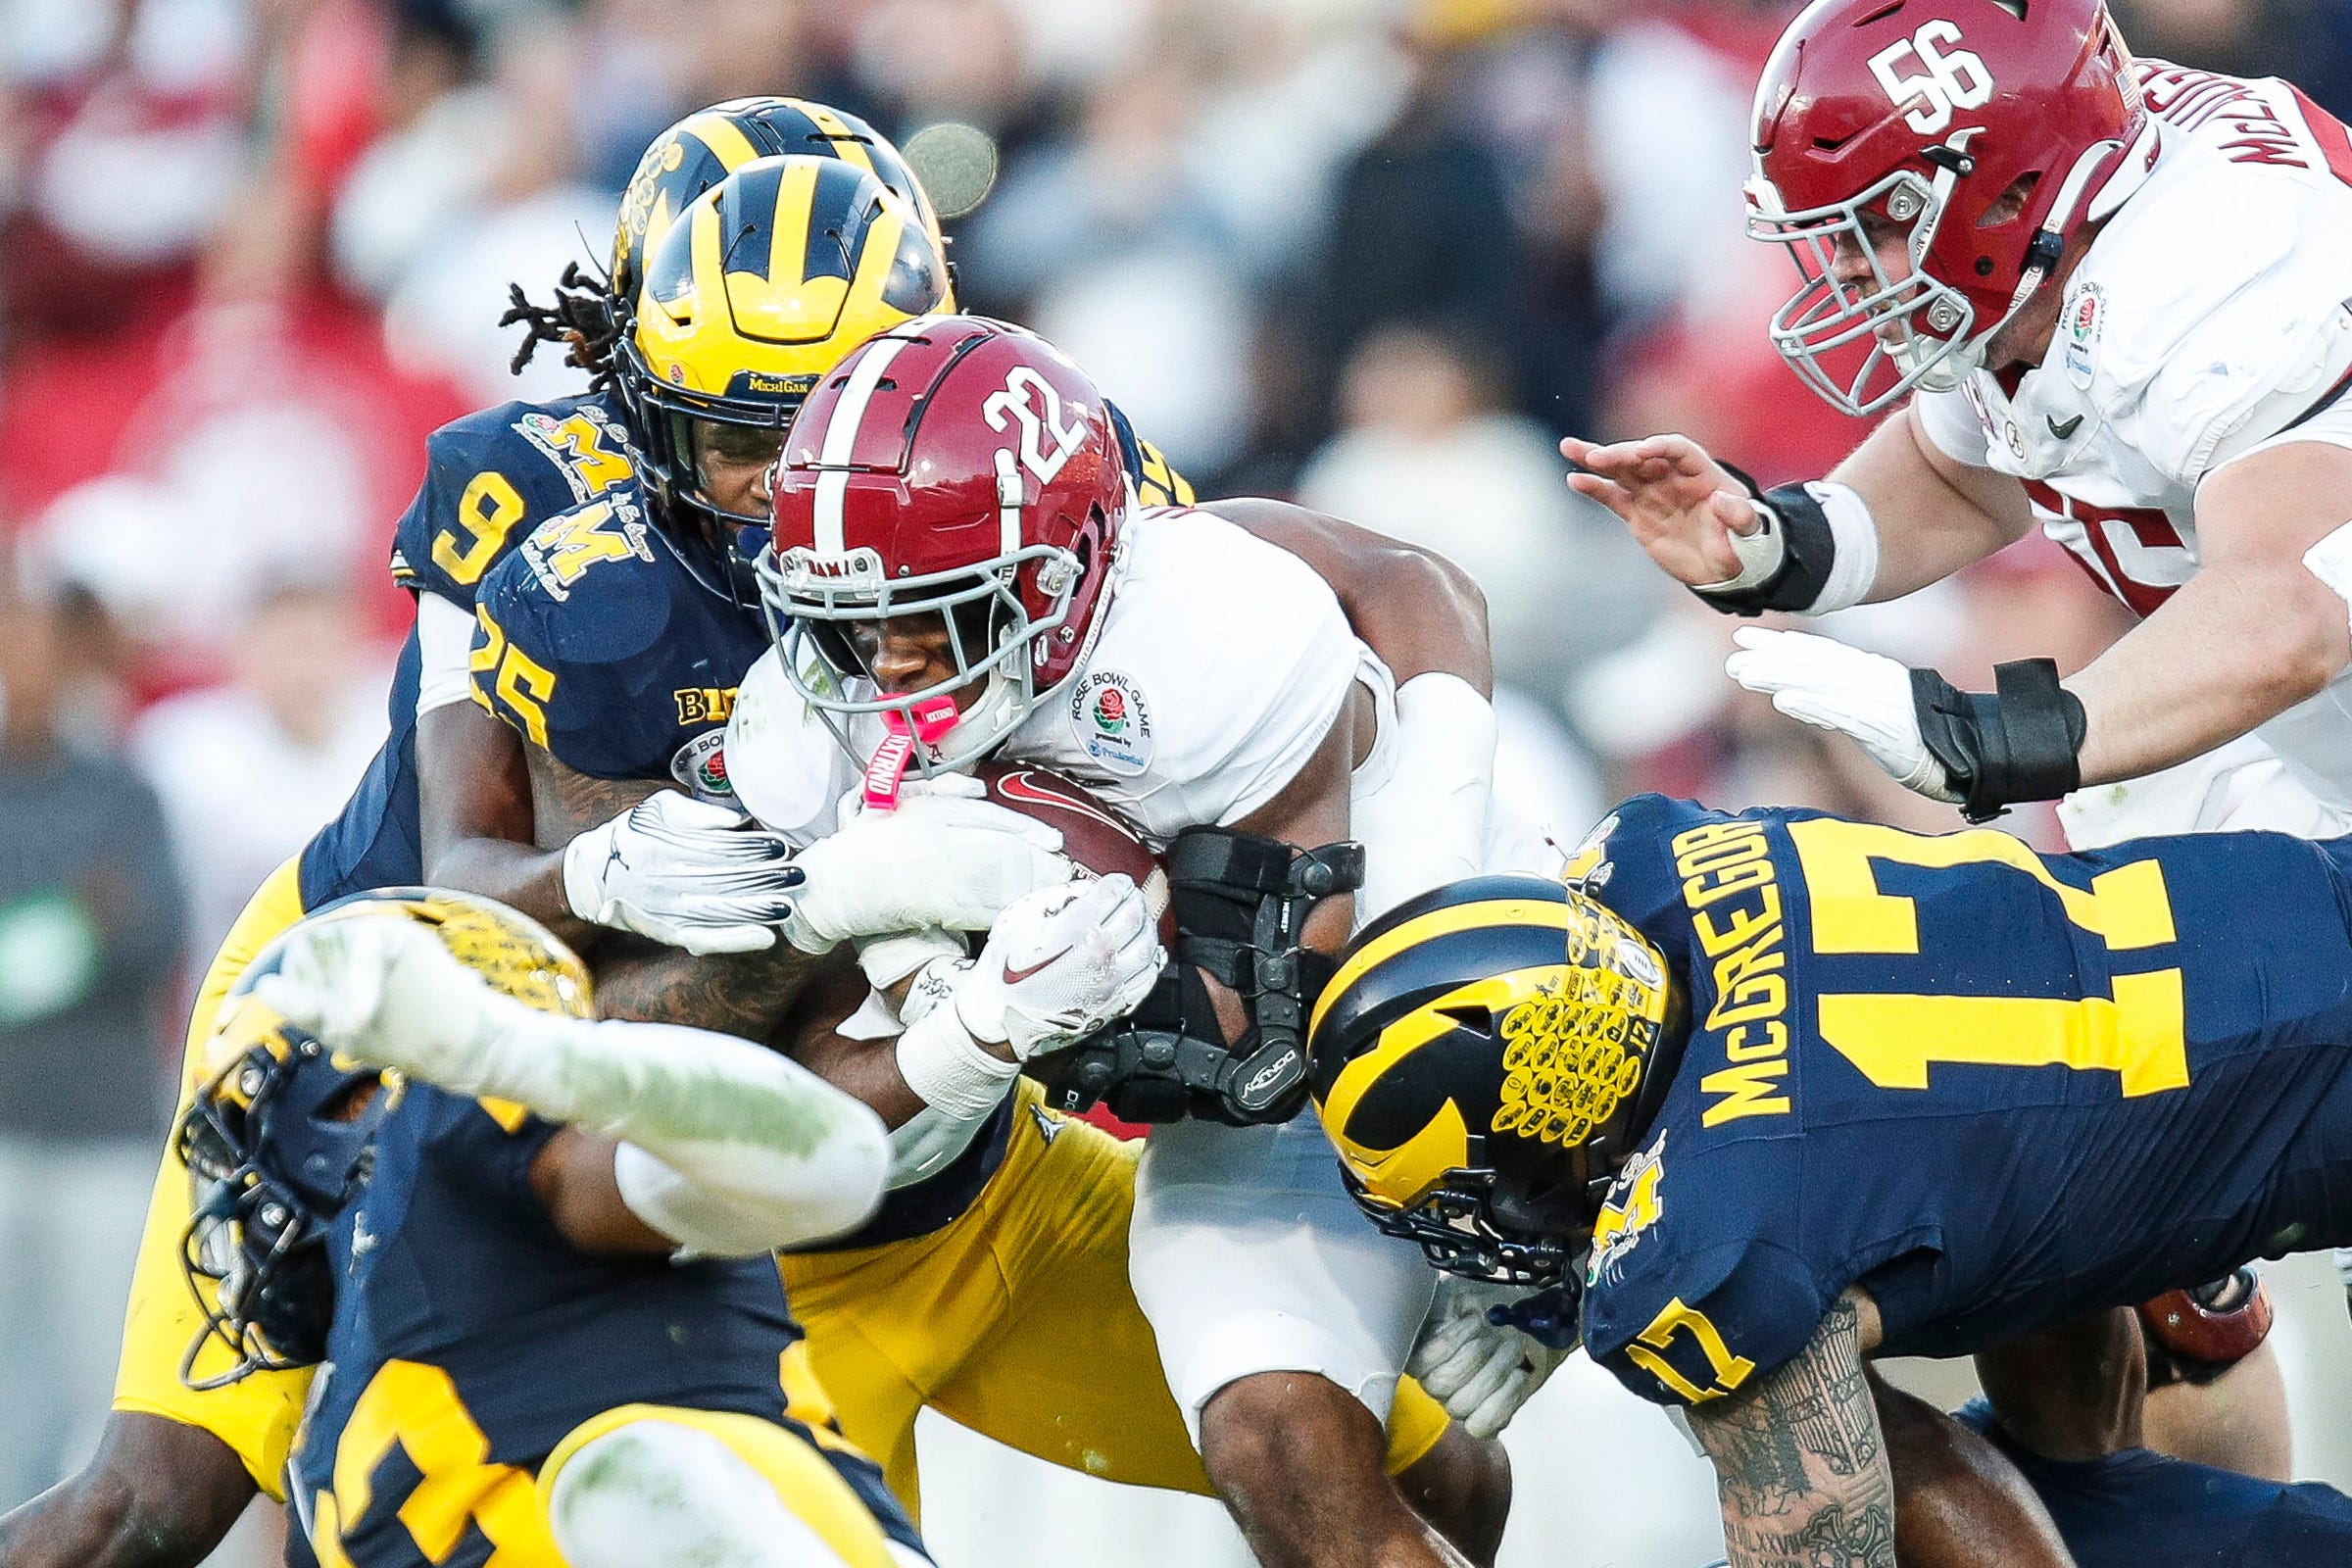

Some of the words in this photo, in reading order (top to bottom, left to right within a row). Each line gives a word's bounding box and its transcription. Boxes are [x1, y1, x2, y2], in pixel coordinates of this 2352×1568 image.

[1867, 19, 1996, 135] 56
[748, 377, 808, 393] MICHIGAN
[981, 365, 1088, 486] 22
[431, 470, 526, 586] 9
[536, 500, 636, 587] M
[469, 602, 558, 753] 25
[1072, 679, 1093, 721] ROSE
[1092, 671, 1130, 693] BOWL
[1130, 689, 1152, 739] GAME
[867, 734, 912, 796] NXTRND
[1670, 819, 1791, 1129] McGREGOR
[1786, 816, 2190, 1099] 17
[1630, 1020, 1652, 1053] 17
[1624, 1296, 1756, 1405] 17
